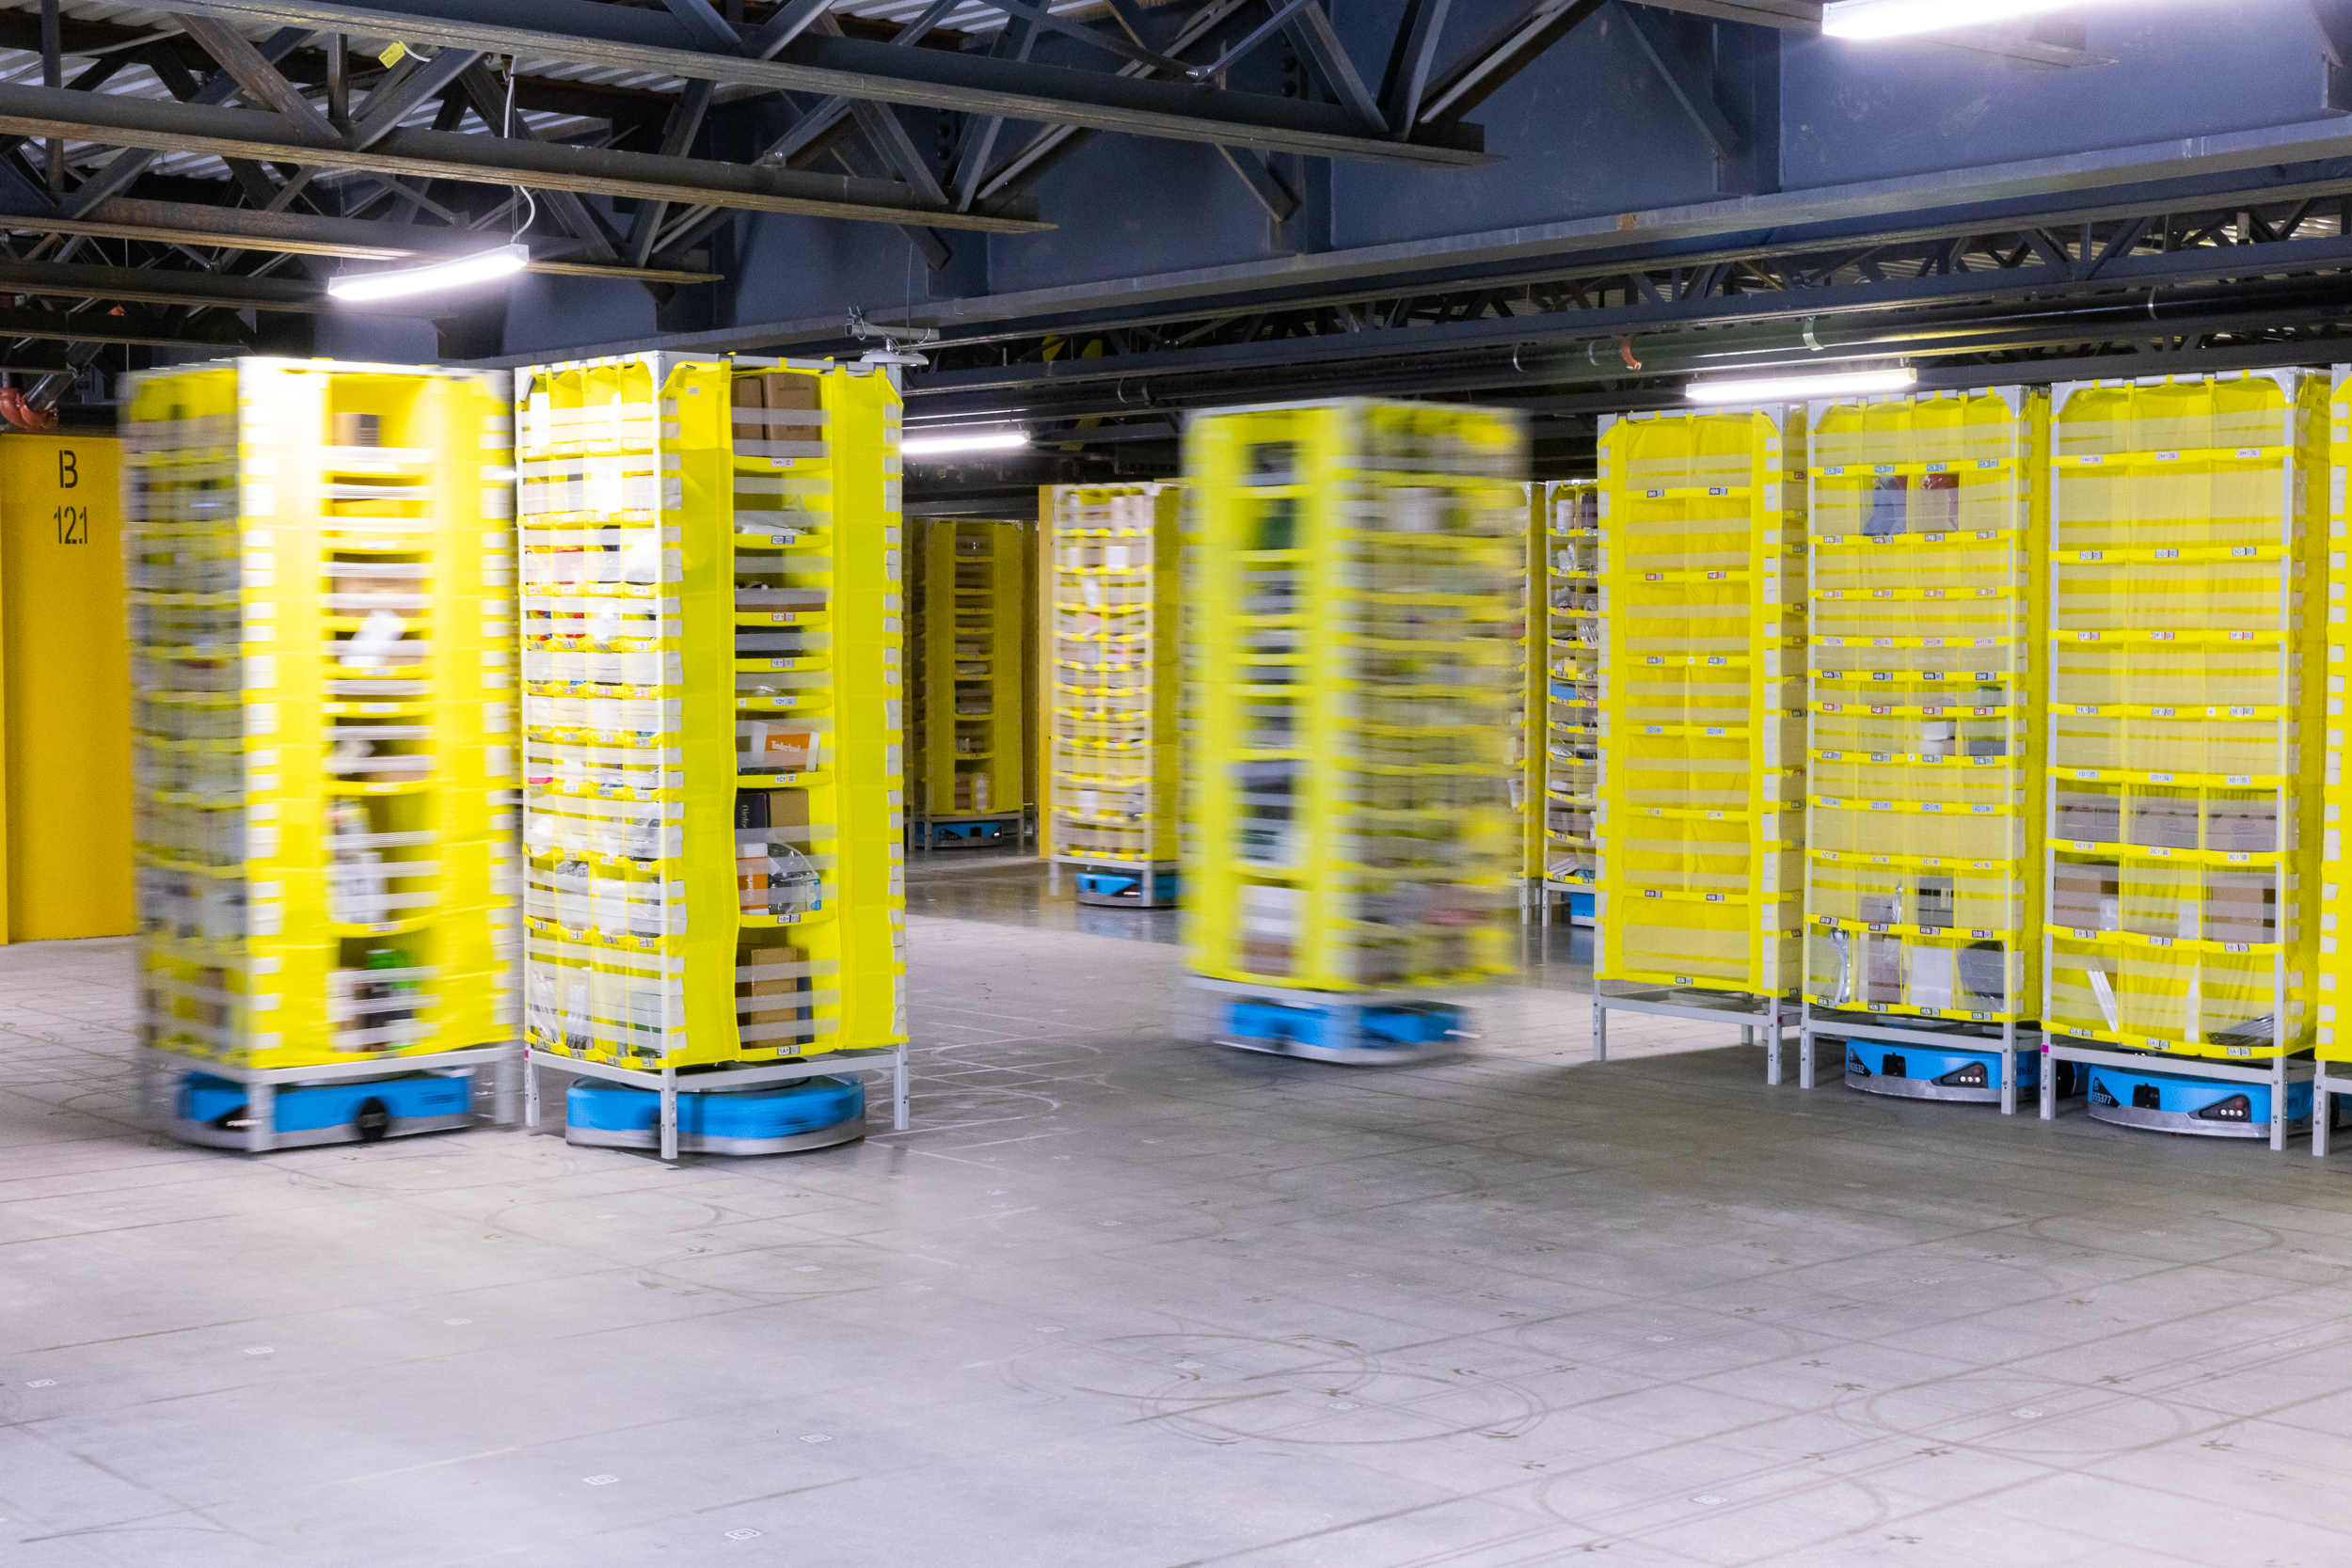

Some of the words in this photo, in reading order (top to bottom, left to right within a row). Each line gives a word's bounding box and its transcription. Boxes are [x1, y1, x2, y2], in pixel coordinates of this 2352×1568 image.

[58, 450, 78, 488] B
[54, 506, 87, 545] 12.1
[2155, 549, 2169, 558] 2G1
[2152, 631, 2165, 640] 2F1
[2230, 631, 2243, 640] 3F1
[771, 739, 801, 753] Timberland
[2149, 847, 2161, 856] 2C1
